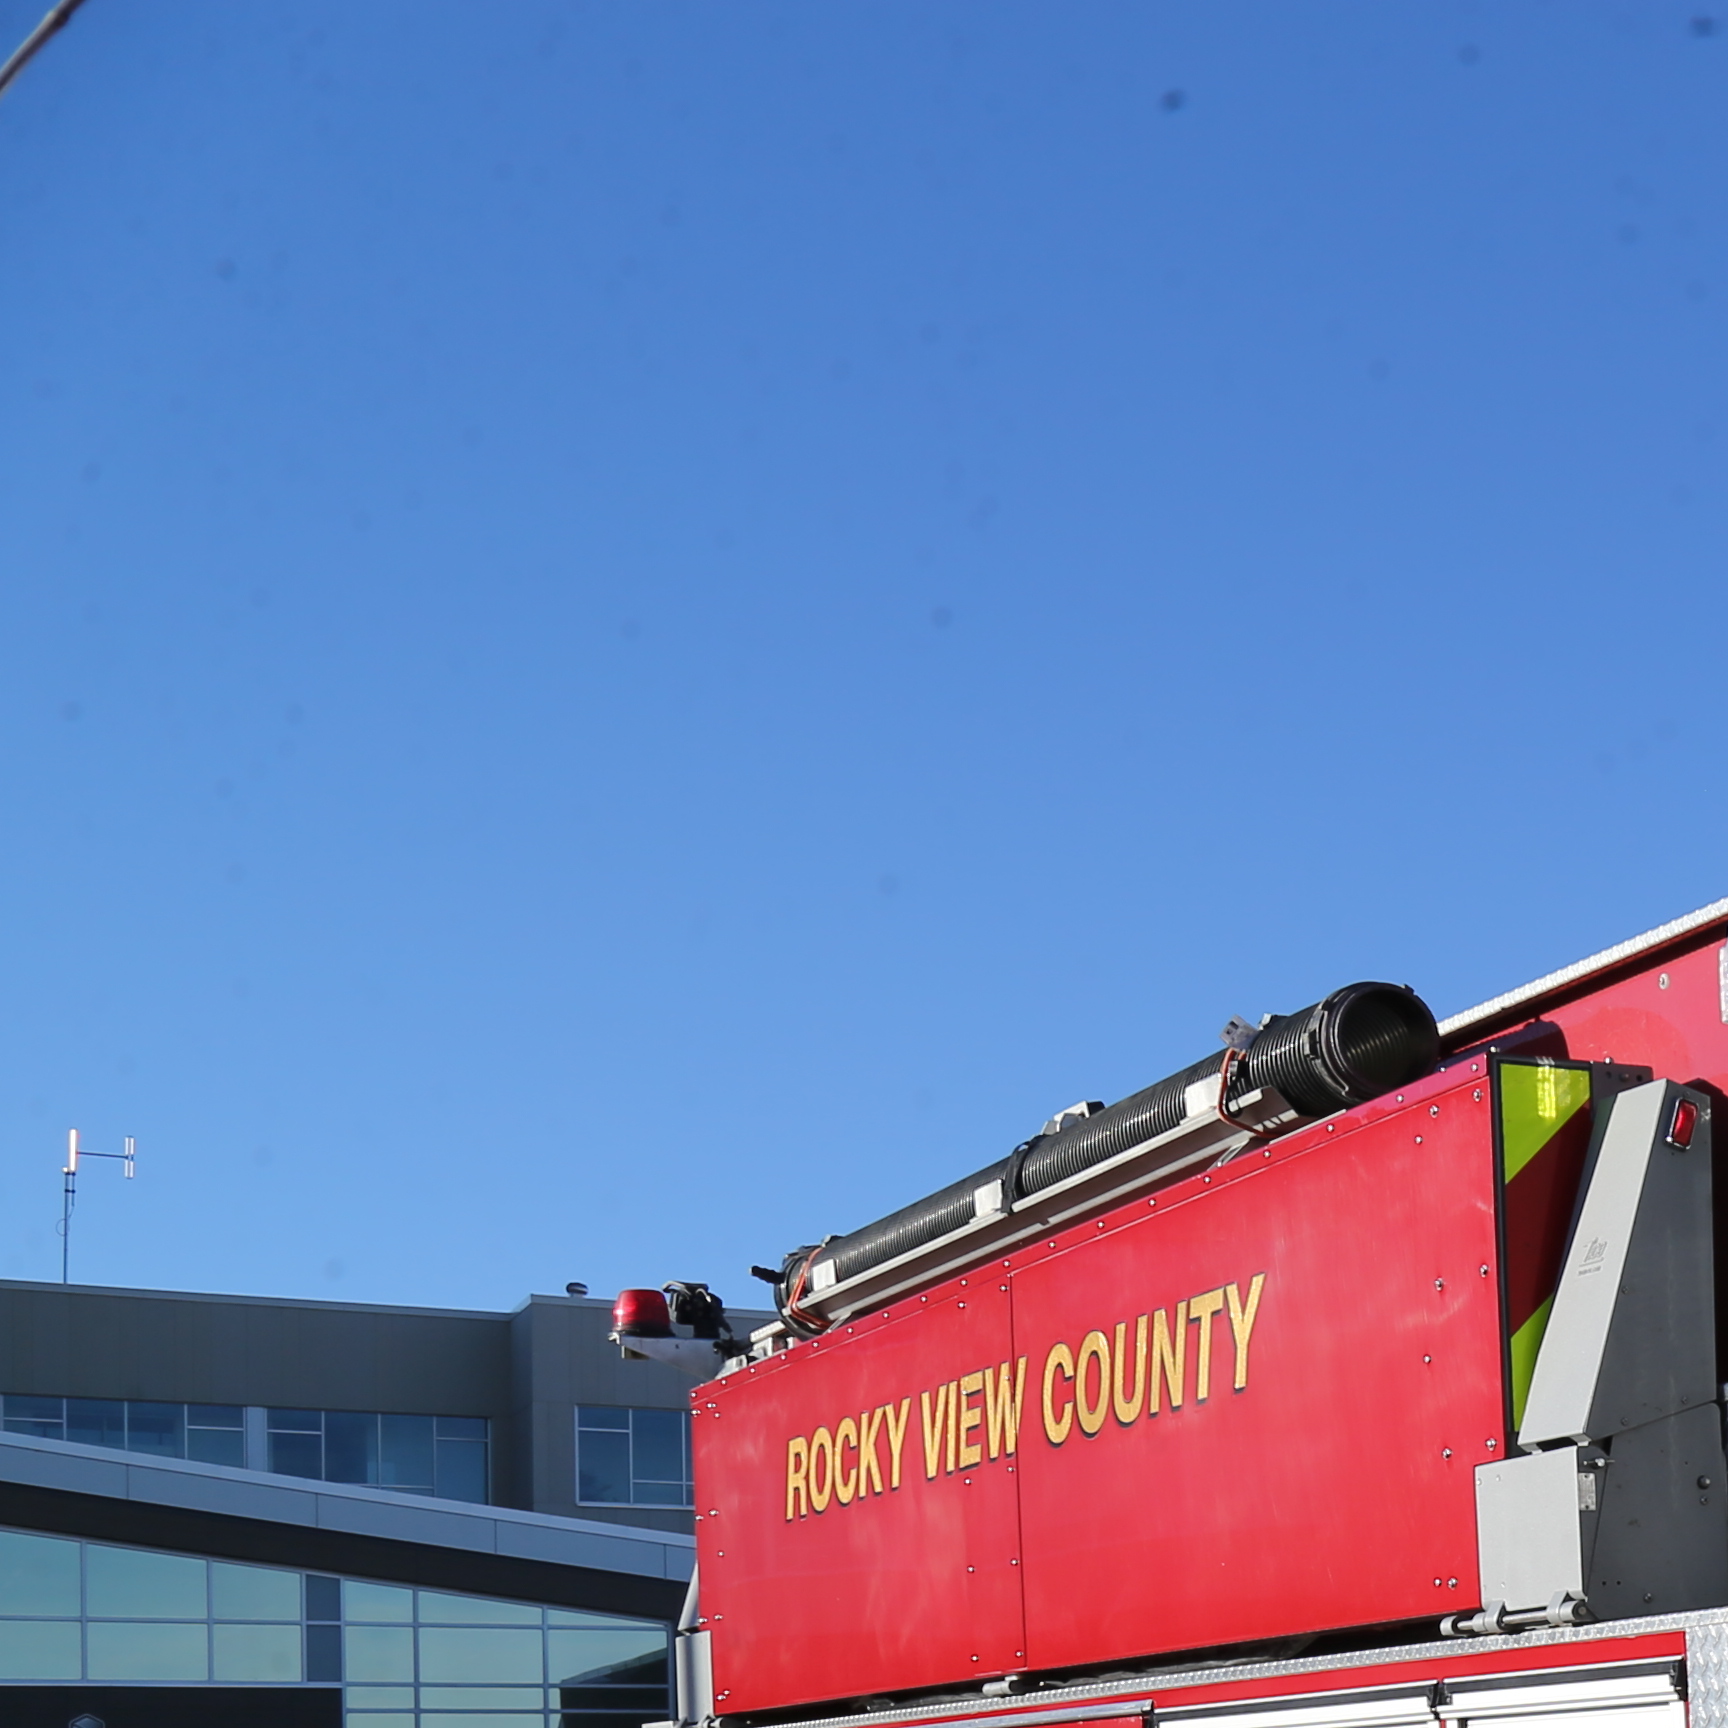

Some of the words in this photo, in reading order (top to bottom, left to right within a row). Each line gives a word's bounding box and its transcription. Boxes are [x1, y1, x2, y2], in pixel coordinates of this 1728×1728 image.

[786, 1397, 911, 1522] ROCKY
[920, 1355, 1028, 1480] VIEW
[1043, 1272, 1266, 1446] COUNTY
